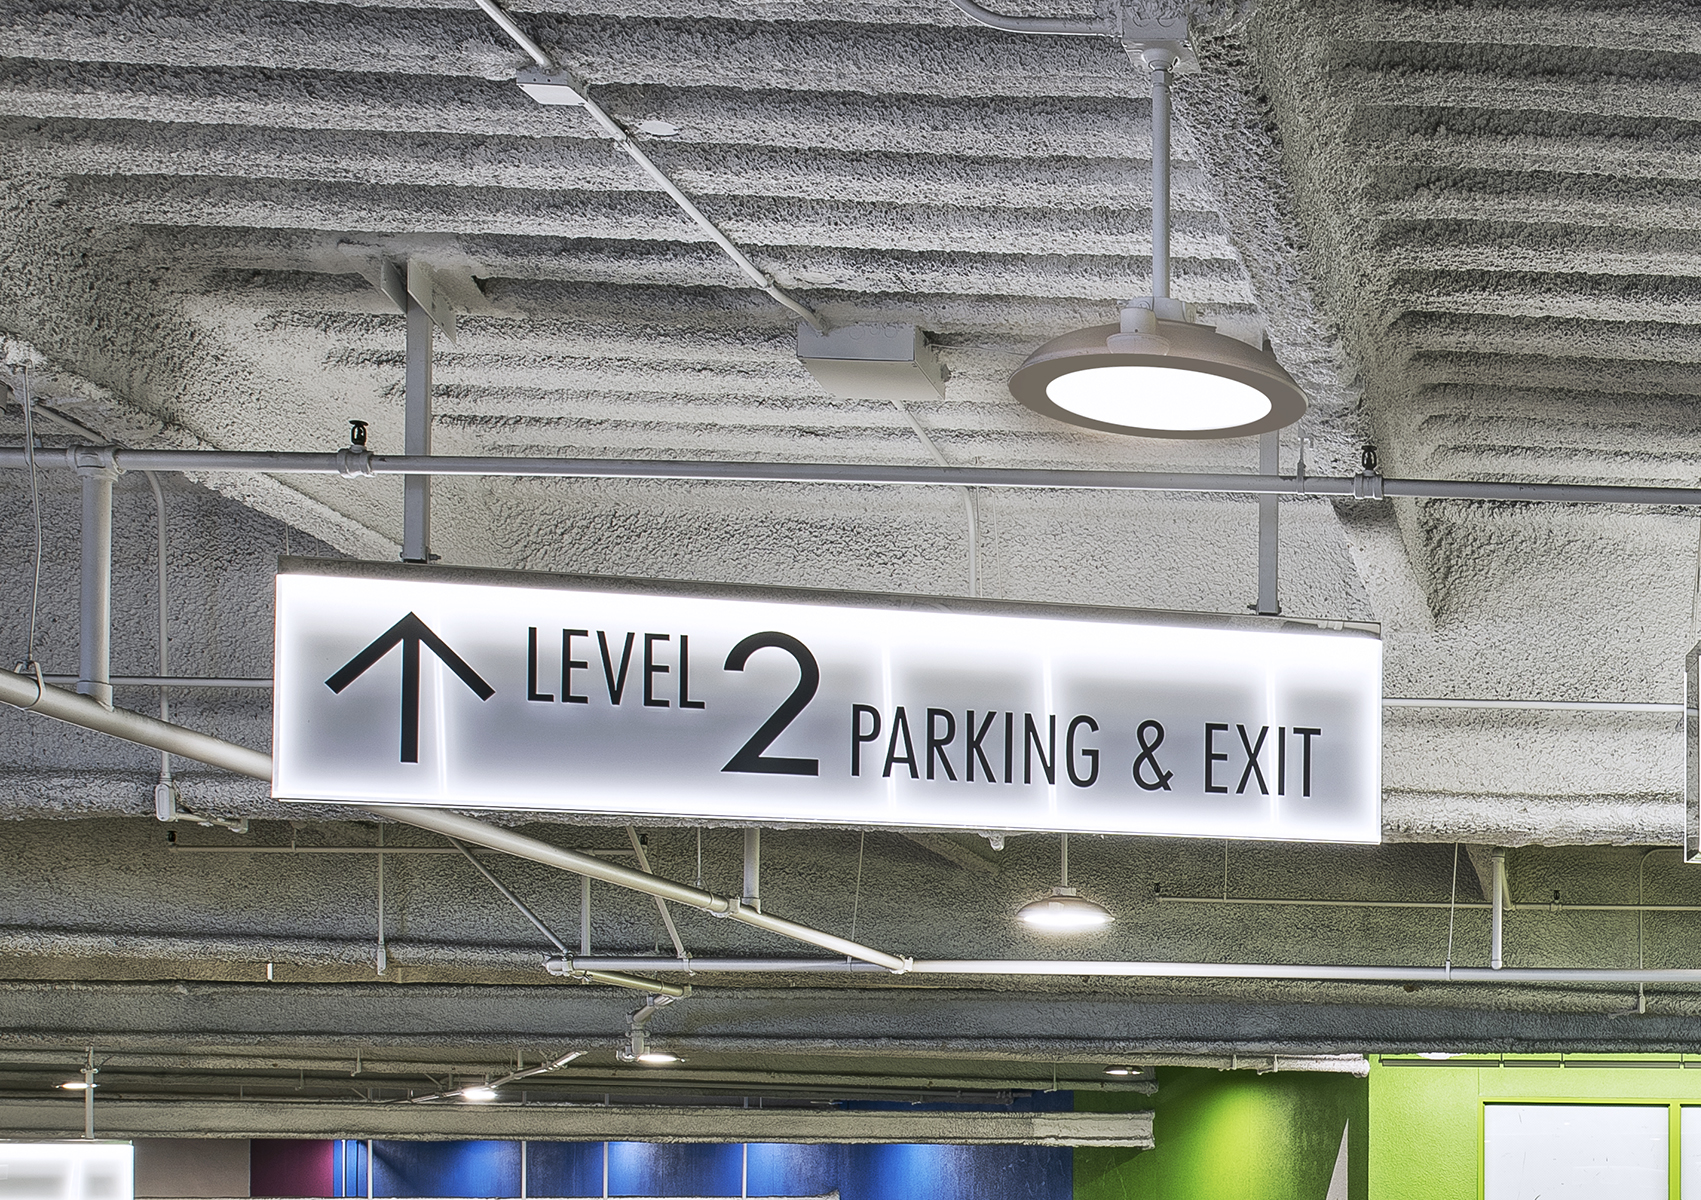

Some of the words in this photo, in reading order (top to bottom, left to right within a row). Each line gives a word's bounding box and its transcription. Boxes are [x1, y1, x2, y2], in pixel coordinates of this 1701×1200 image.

[527, 626, 705, 710] LEVEL
[720, 631, 820, 776] 2
[851, 703, 1100, 788] PARKING
[1132, 719, 1173, 792] &
[1204, 722, 1321, 798] EXIT
